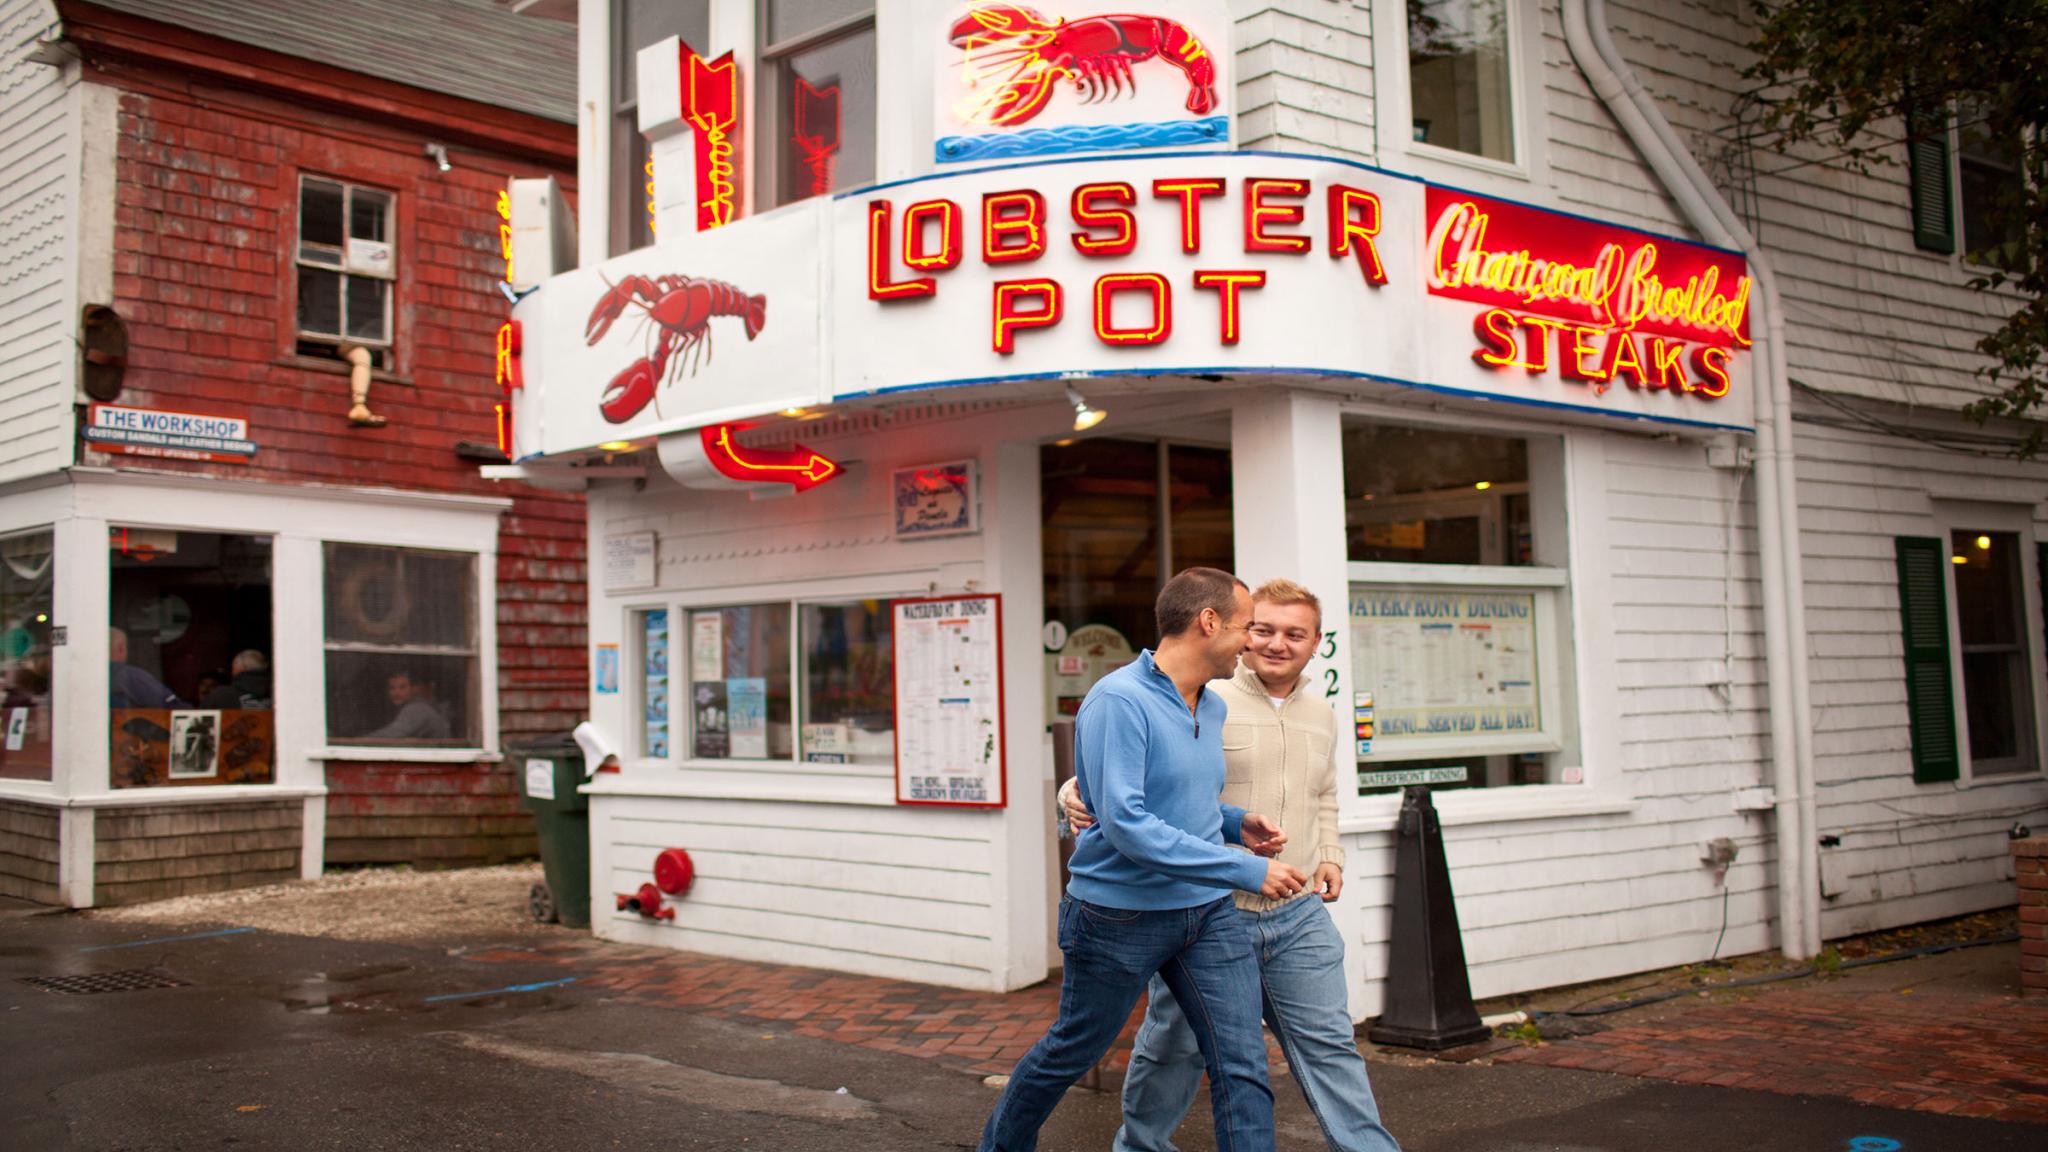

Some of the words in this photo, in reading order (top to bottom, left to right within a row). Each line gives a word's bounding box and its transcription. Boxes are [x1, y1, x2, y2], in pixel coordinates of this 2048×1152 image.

[869, 177, 1388, 300] LOBSTER
[1427, 202, 1625, 329] Charcoal
[1618, 243, 1753, 344] Broiled
[993, 270, 1266, 353] POT
[1472, 310, 1731, 401] STEAKS
[102, 409, 137, 428] THE
[141, 413, 239, 436] WORKSHOP
[88, 427, 126, 439] CUSTOM
[127, 430, 167, 444] SANDALS
[168, 434, 182, 445] and
[185, 436, 222, 449] LEATHER
[223, 440, 255, 453] DESIGN
[1467, 600, 1529, 618] DINING
[1479, 711, 1504, 731] ALL
[1359, 770, 1424, 785] WATERFRONT
[1429, 767, 1464, 781] DINING
